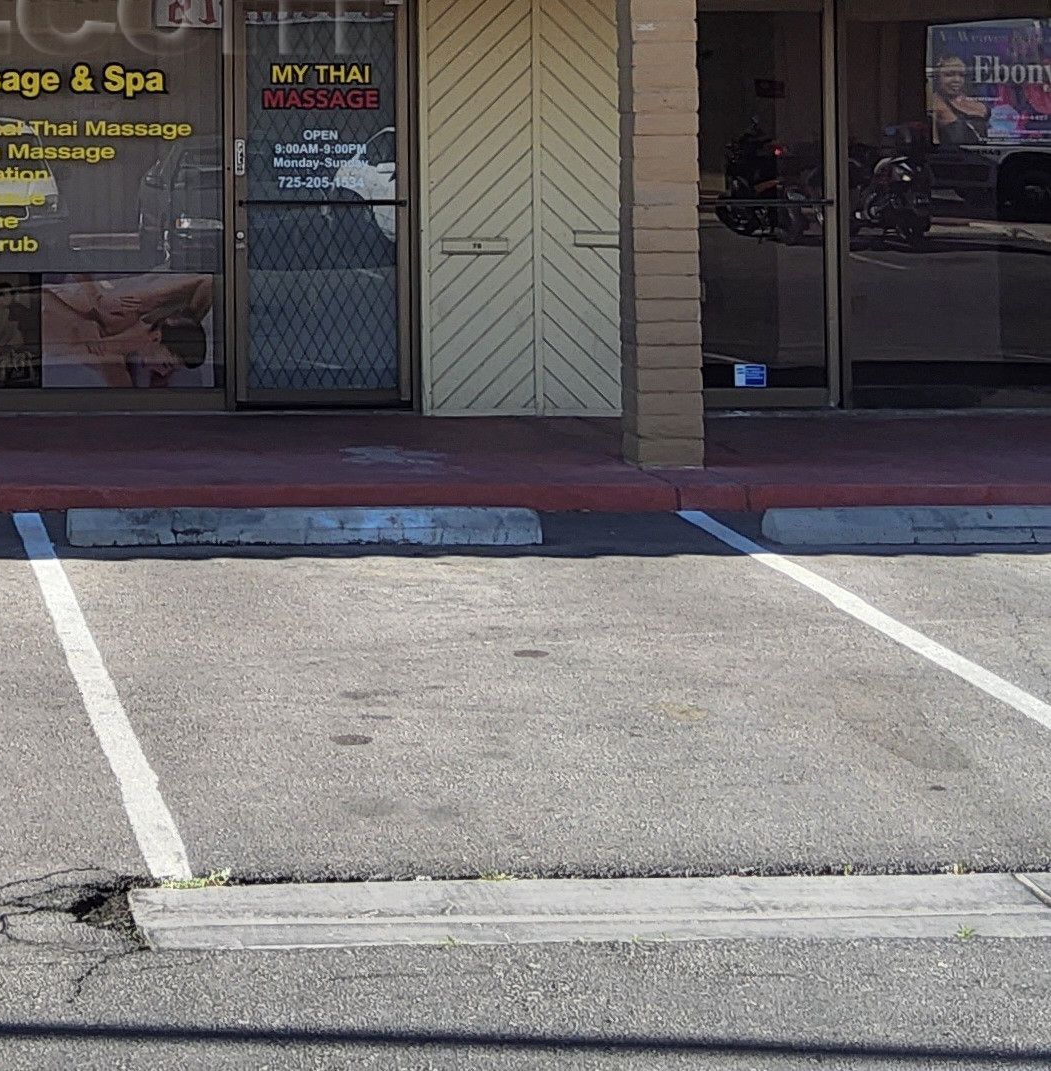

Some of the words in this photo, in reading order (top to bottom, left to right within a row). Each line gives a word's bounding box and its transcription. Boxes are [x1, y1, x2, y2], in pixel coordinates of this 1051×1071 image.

[70, 66, 94, 91] &
[103, 65, 164, 96] Spa
[271, 64, 309, 83] MY
[314, 64, 370, 83] THAI
[262, 89, 379, 109] MASSAGE
[32, 120, 78, 136] Thai
[84, 120, 192, 140] Massage
[303, 130, 338, 141] OPEN
[7, 143, 116, 163] Massage
[274, 143, 367, 155] 9:00AM-9:00PM
[273, 157, 369, 170] Monday-Sunday
